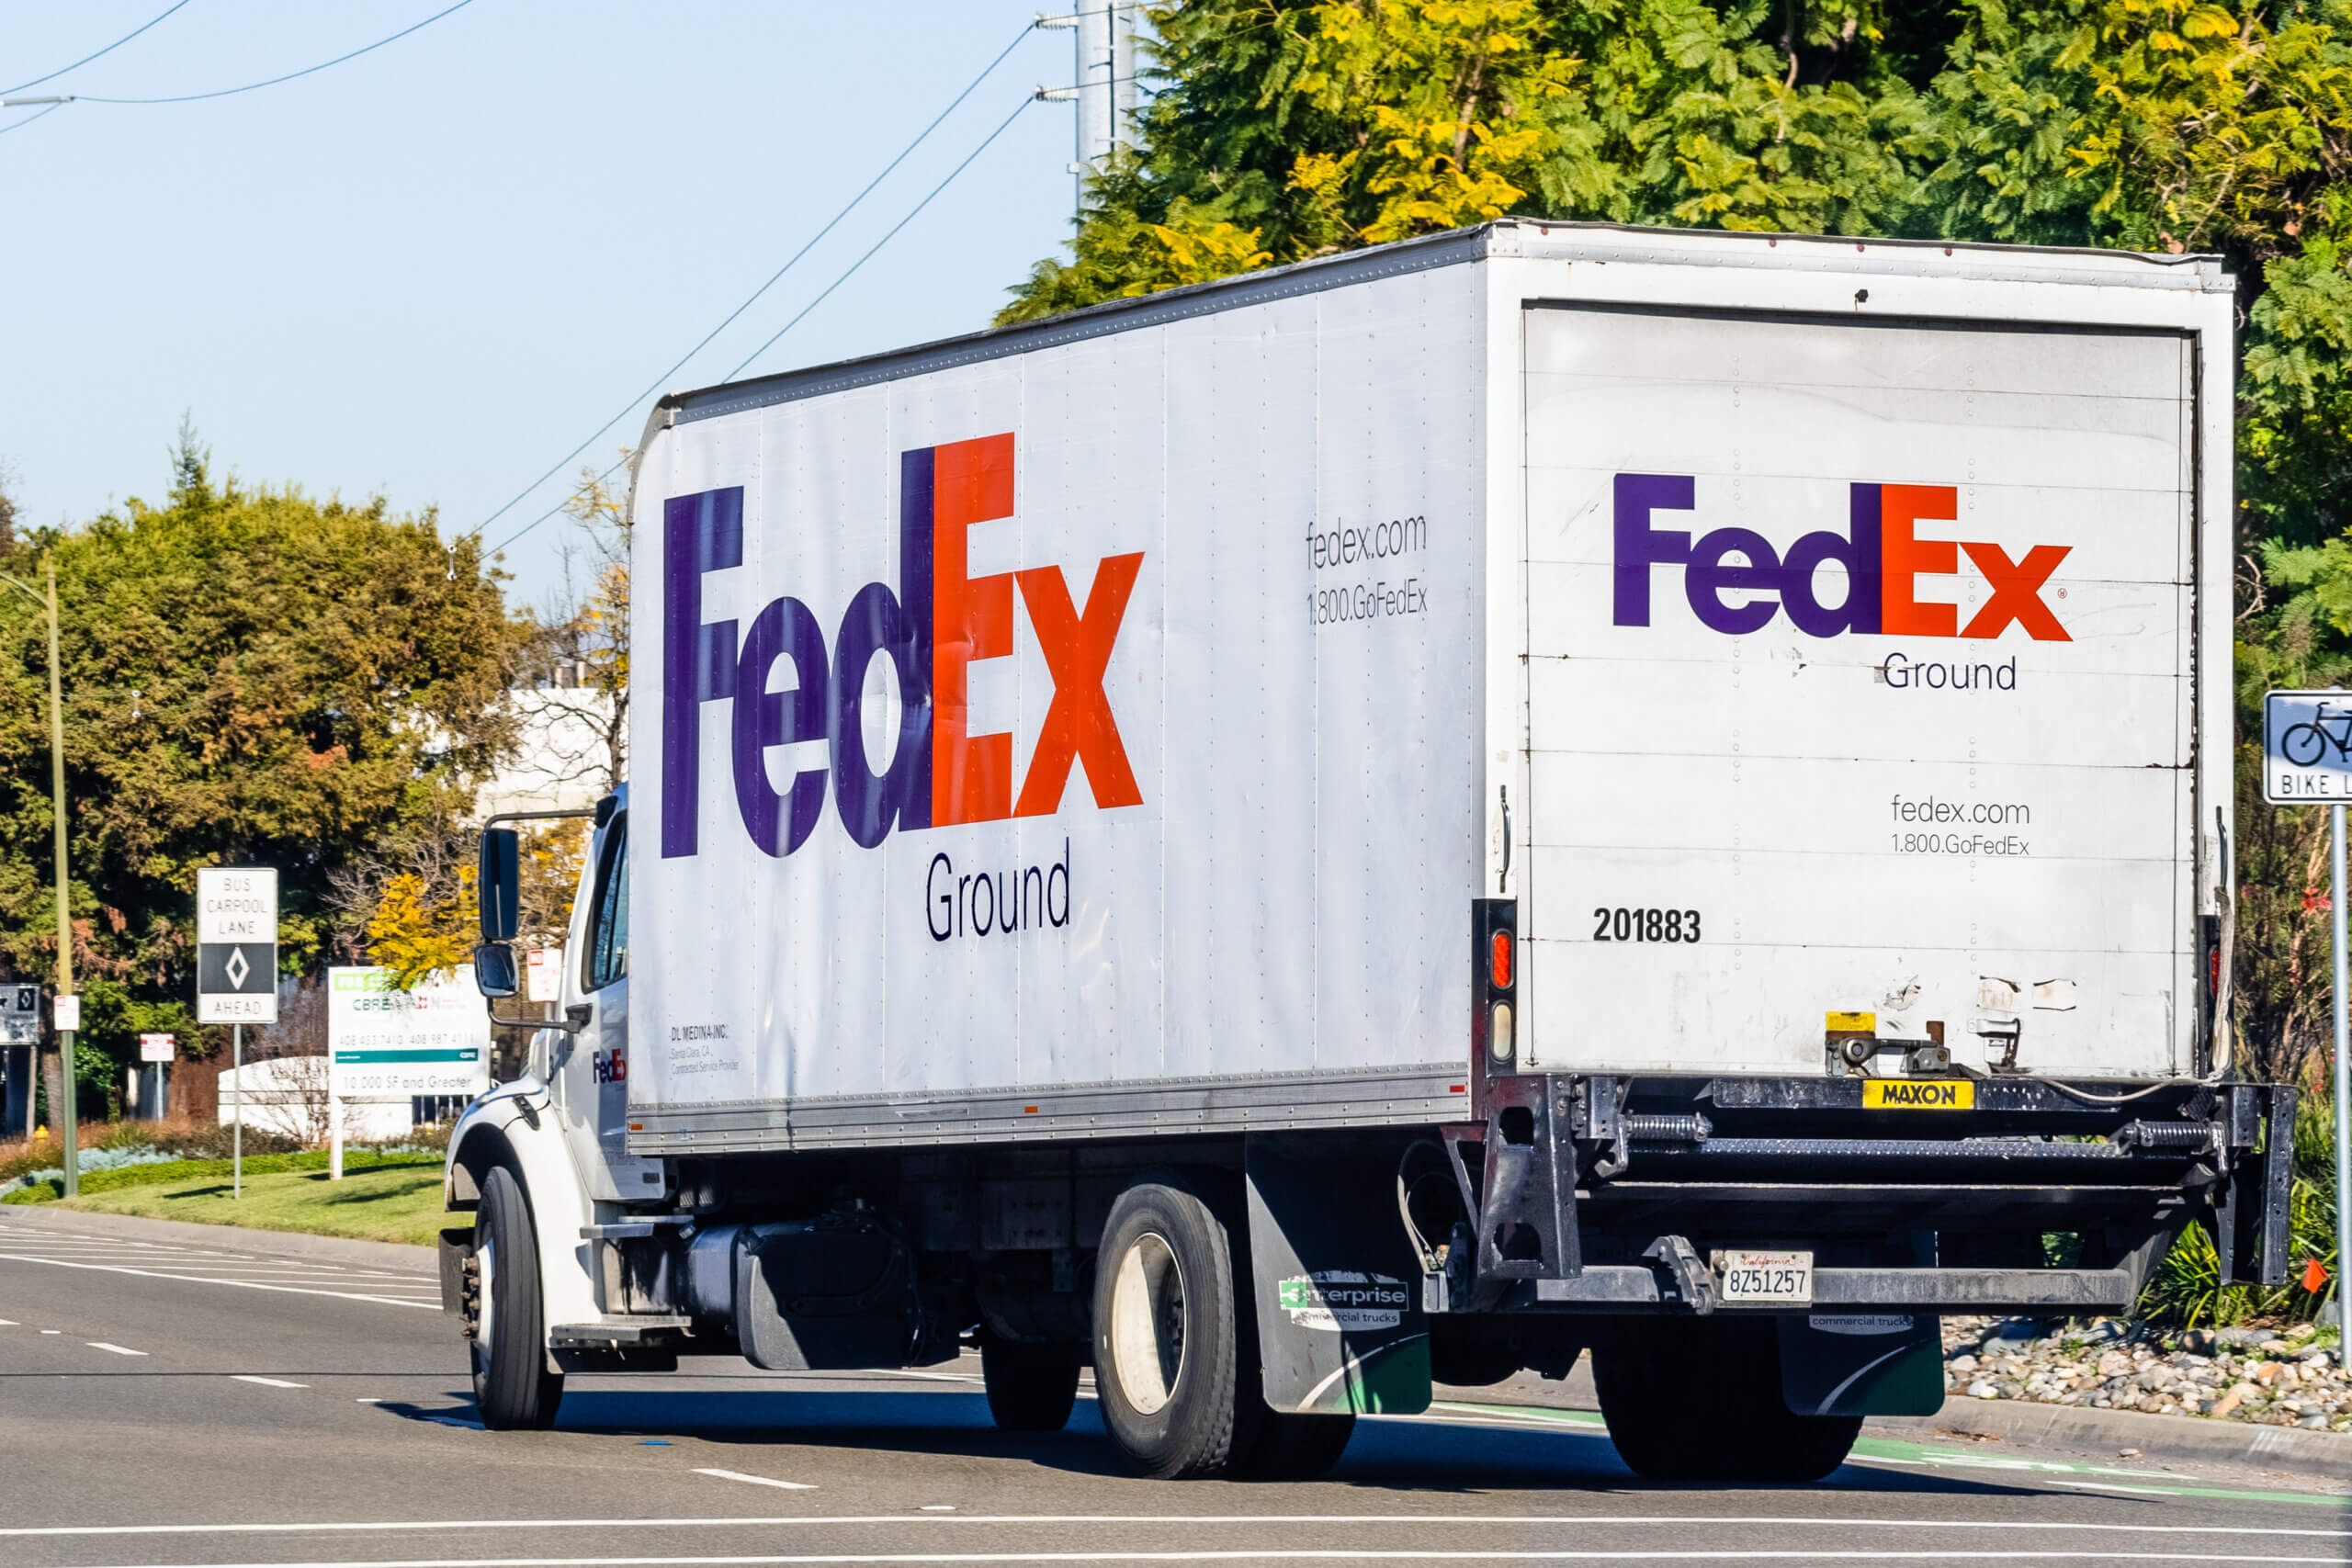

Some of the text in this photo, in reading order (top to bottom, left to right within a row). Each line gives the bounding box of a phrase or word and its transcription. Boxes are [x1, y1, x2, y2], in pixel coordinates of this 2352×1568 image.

[1306, 515, 1427, 570] fedex.com
[1613, 473, 2074, 641] FedEx
[1307, 578, 1428, 626] 1.800.GoFedEx
[661, 432, 1145, 860] FedEx
[1883, 652, 2016, 691] Ground
[2281, 774, 2329, 795] BIKE
[1891, 794, 2030, 824] fedex.com
[1891, 833, 2030, 855] 1.800.GoFedEx
[222, 877, 251, 892] BUS
[925, 837, 1071, 942] Ground
[207, 898, 268, 913] CARPOOL
[219, 920, 256, 934] LANE
[1593, 908, 1702, 943] 201883
[214, 1000, 263, 1015] AHEAD
[672, 1026, 682, 1042] DL
[683, 1024, 712, 1041] MEDINA
[402, 1076, 424, 1089] and
[428, 1075, 471, 1089] Greater
[1882, 1084, 1956, 1105] MAXON
[1742, 1254, 1793, 1269] California
[1730, 1269, 1806, 1293] 8Z51257
[1363, 1312, 1397, 1324] trucks
[1813, 1315, 1875, 1325] commercial
